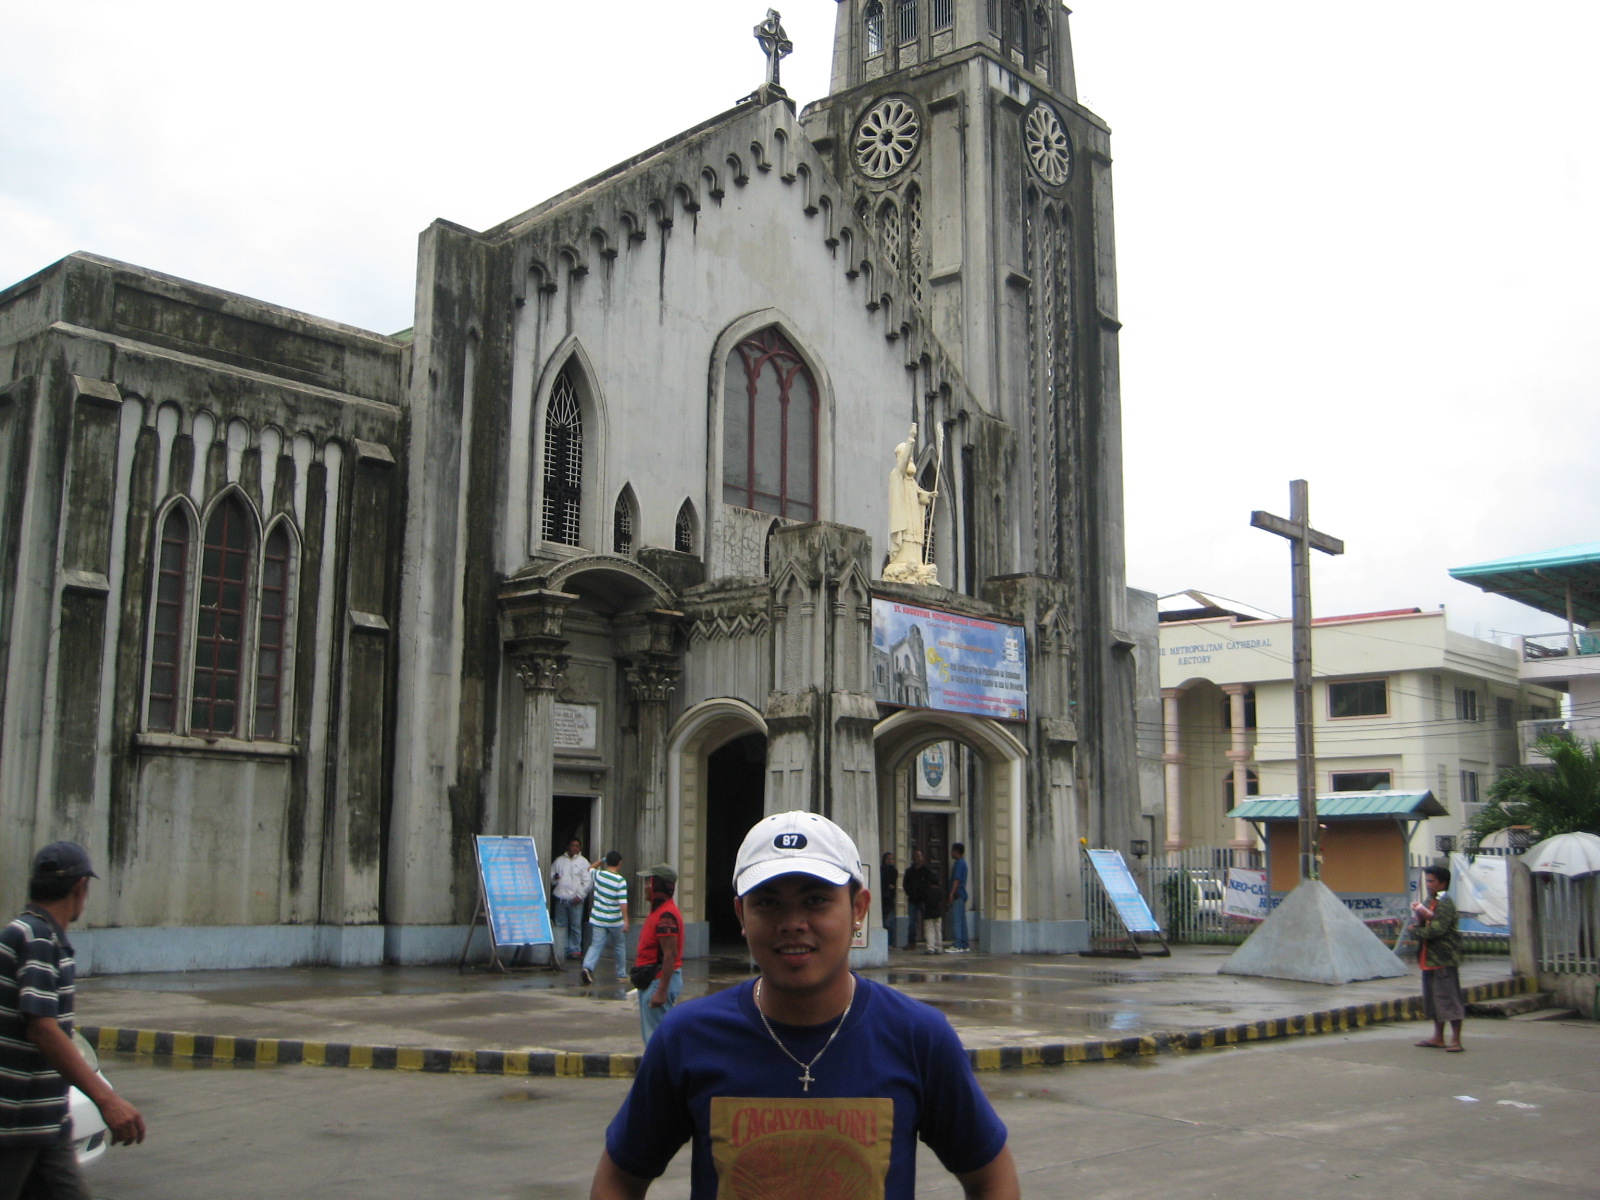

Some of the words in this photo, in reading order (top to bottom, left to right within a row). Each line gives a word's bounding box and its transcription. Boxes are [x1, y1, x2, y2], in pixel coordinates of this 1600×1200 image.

[1169, 643, 1223, 655] METROPOLITAN
[1226, 638, 1272, 650] CATHEDRAL
[1178, 655, 1212, 666] RECTORY
[782, 835, 798, 847] 87
